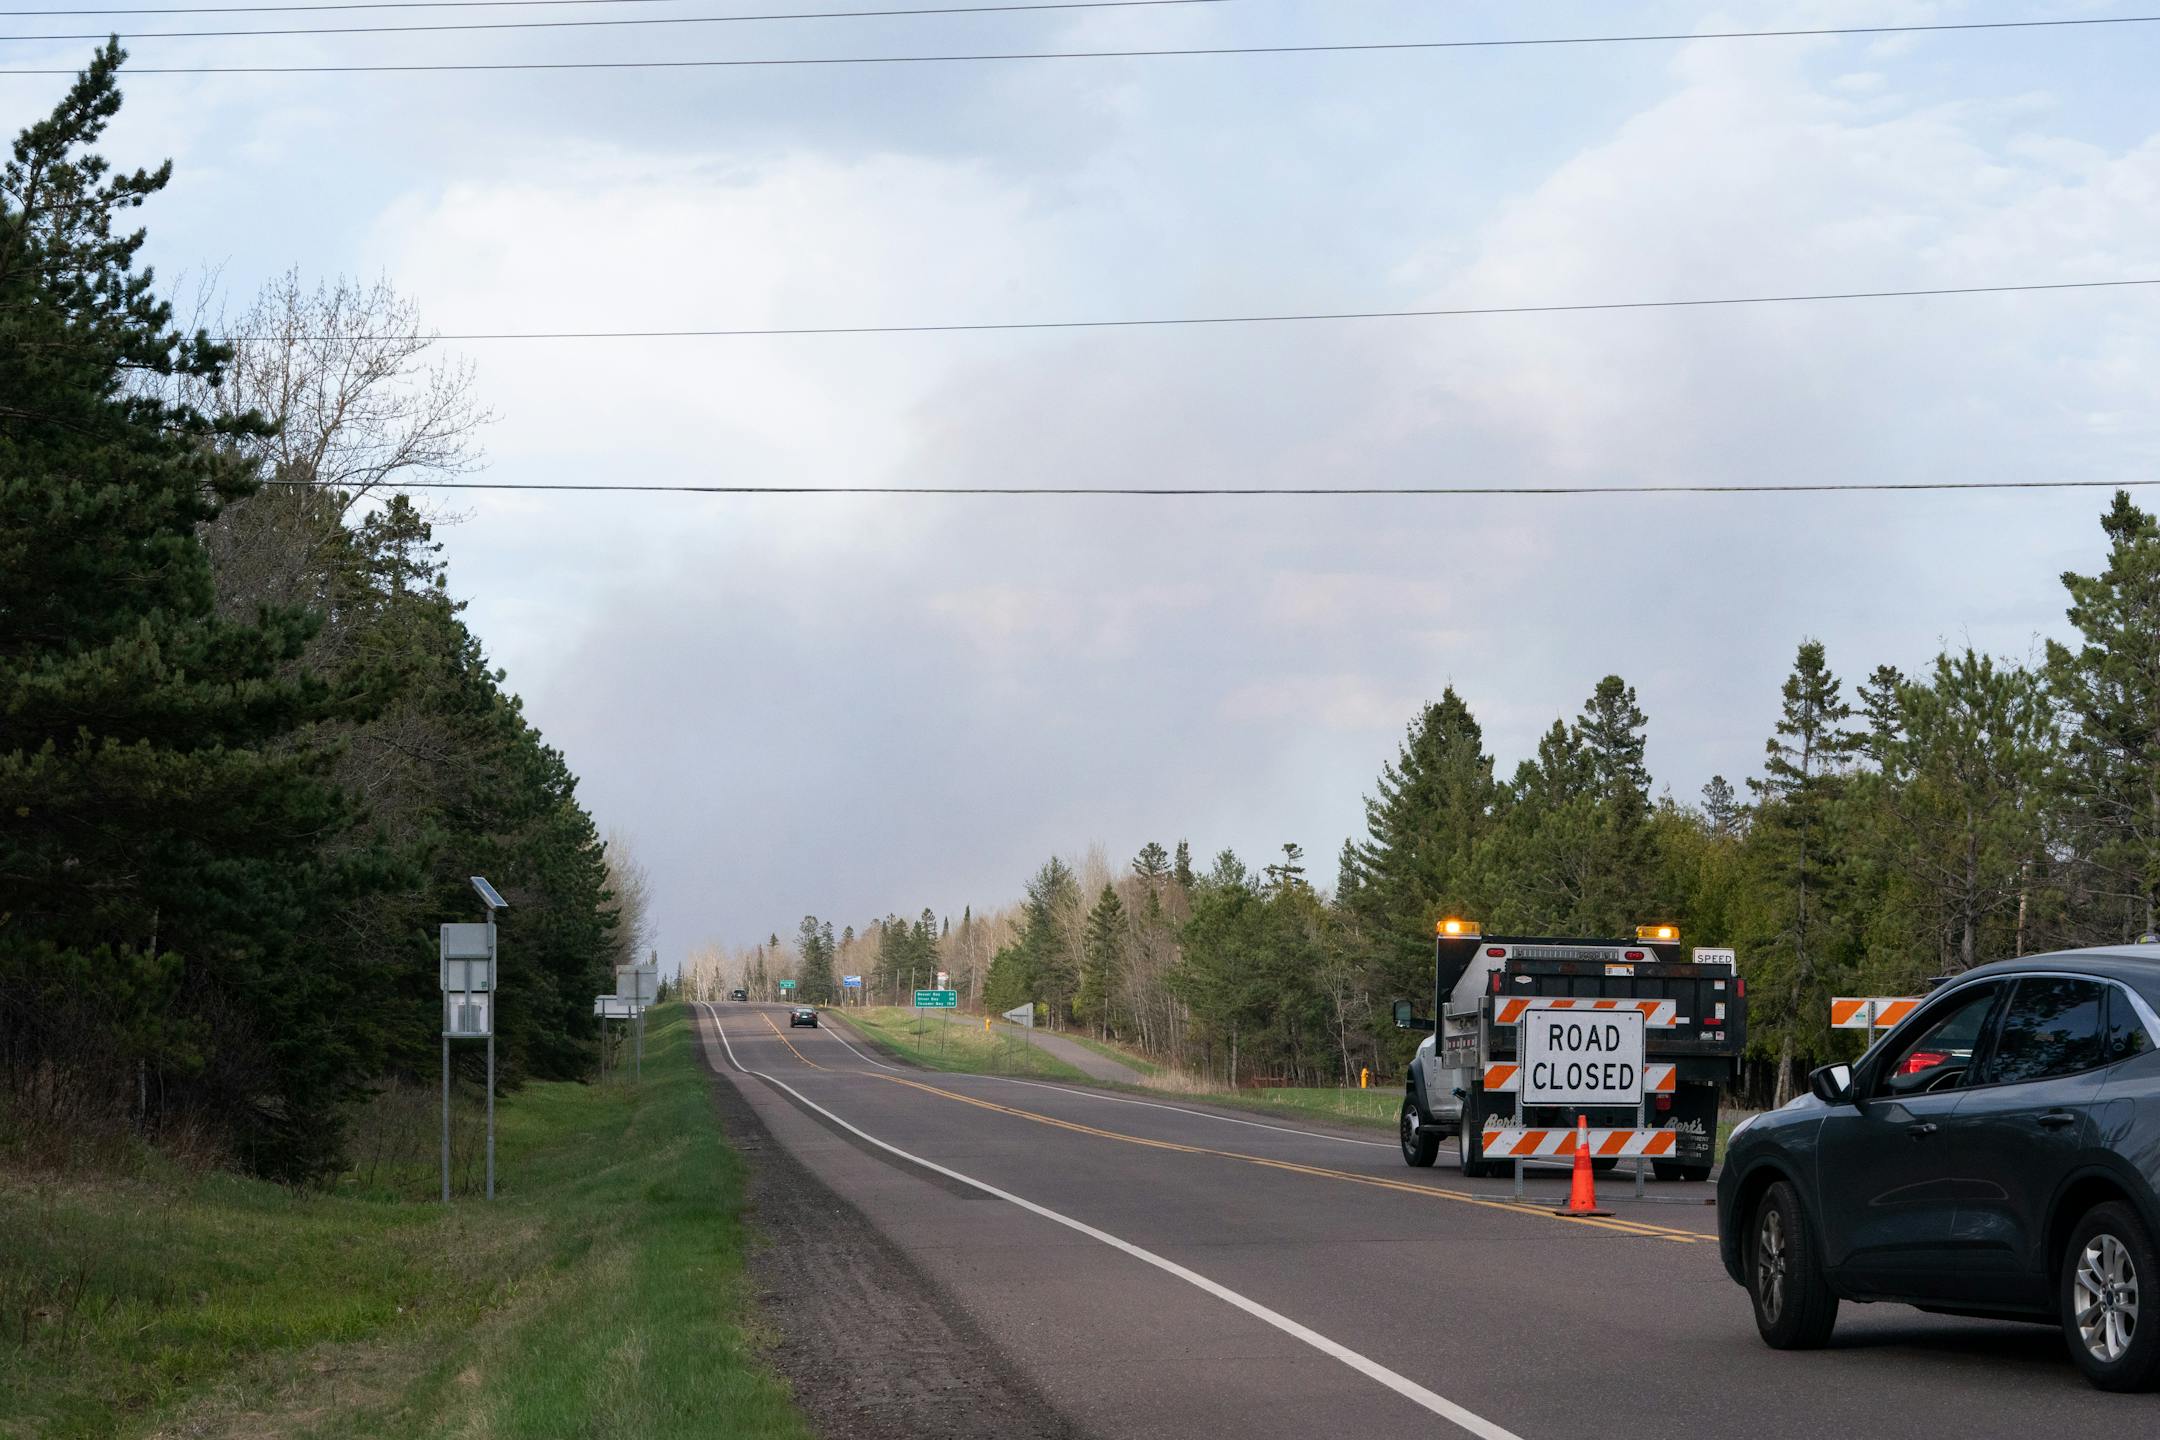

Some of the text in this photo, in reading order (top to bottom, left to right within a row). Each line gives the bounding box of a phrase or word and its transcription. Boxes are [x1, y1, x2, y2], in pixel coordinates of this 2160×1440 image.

[1697, 954, 1732, 963] SPEED
[1549, 1023, 1621, 1052] ROAD
[1533, 1062, 1634, 1090] CLOSED
